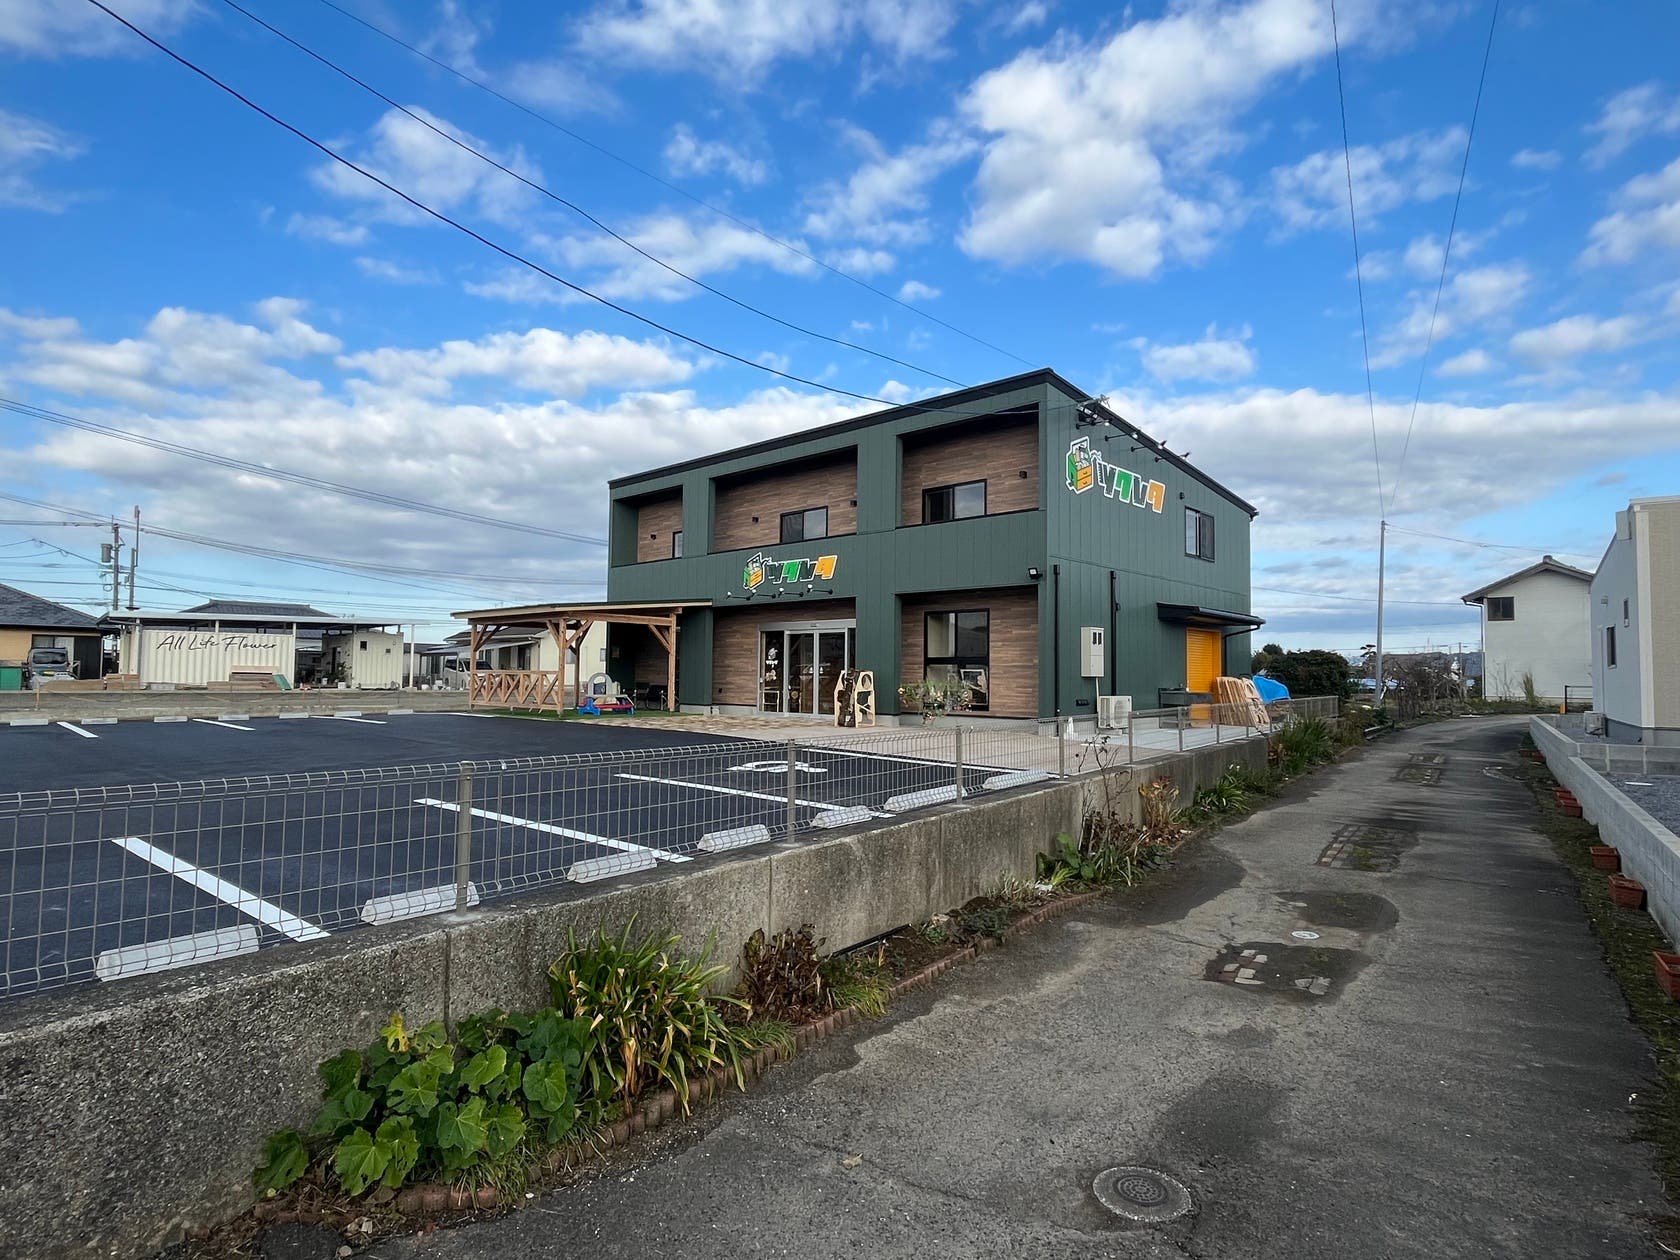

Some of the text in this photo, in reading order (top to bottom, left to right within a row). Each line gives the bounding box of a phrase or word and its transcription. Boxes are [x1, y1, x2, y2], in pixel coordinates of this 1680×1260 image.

[157, 634, 277, 652] All Life Flower
